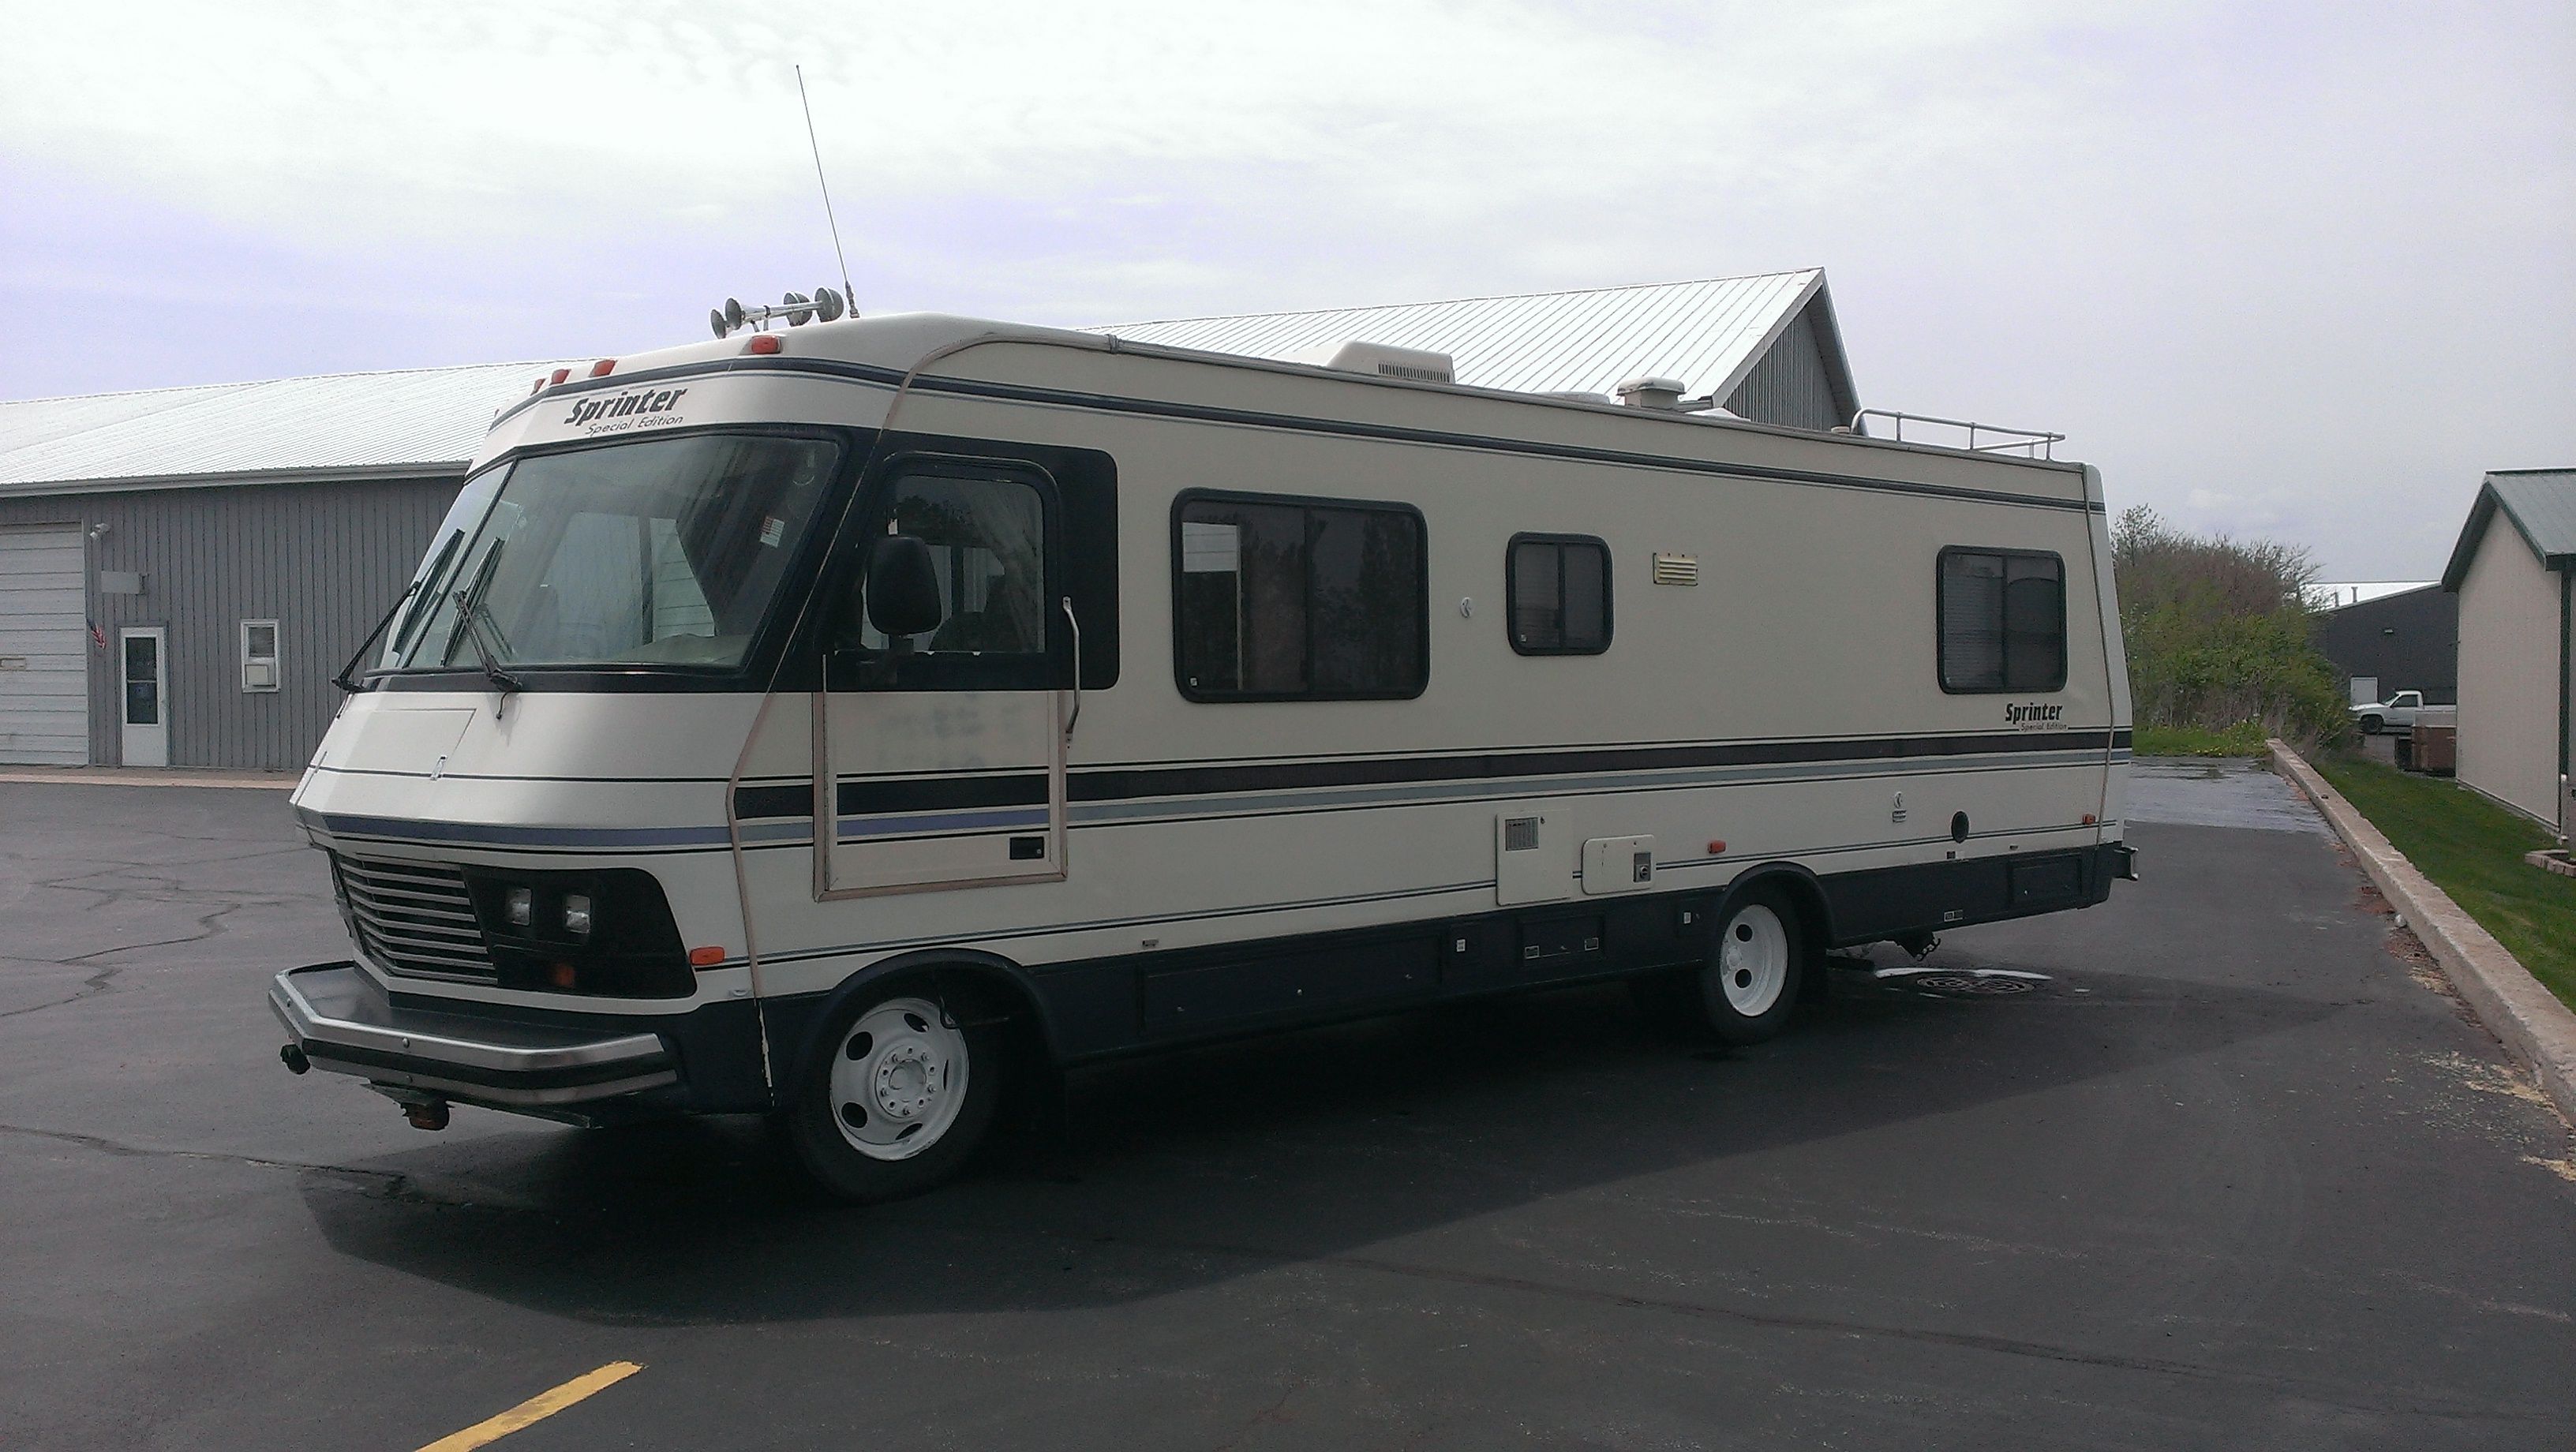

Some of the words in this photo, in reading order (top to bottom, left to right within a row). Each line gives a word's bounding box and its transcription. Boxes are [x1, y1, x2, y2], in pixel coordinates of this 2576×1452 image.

[564, 388, 688, 426] Sprinter
[585, 418, 635, 436] Special
[638, 414, 684, 428] Edition
[2005, 702, 2062, 724] Sprinter
[2021, 723, 2044, 732] Special
